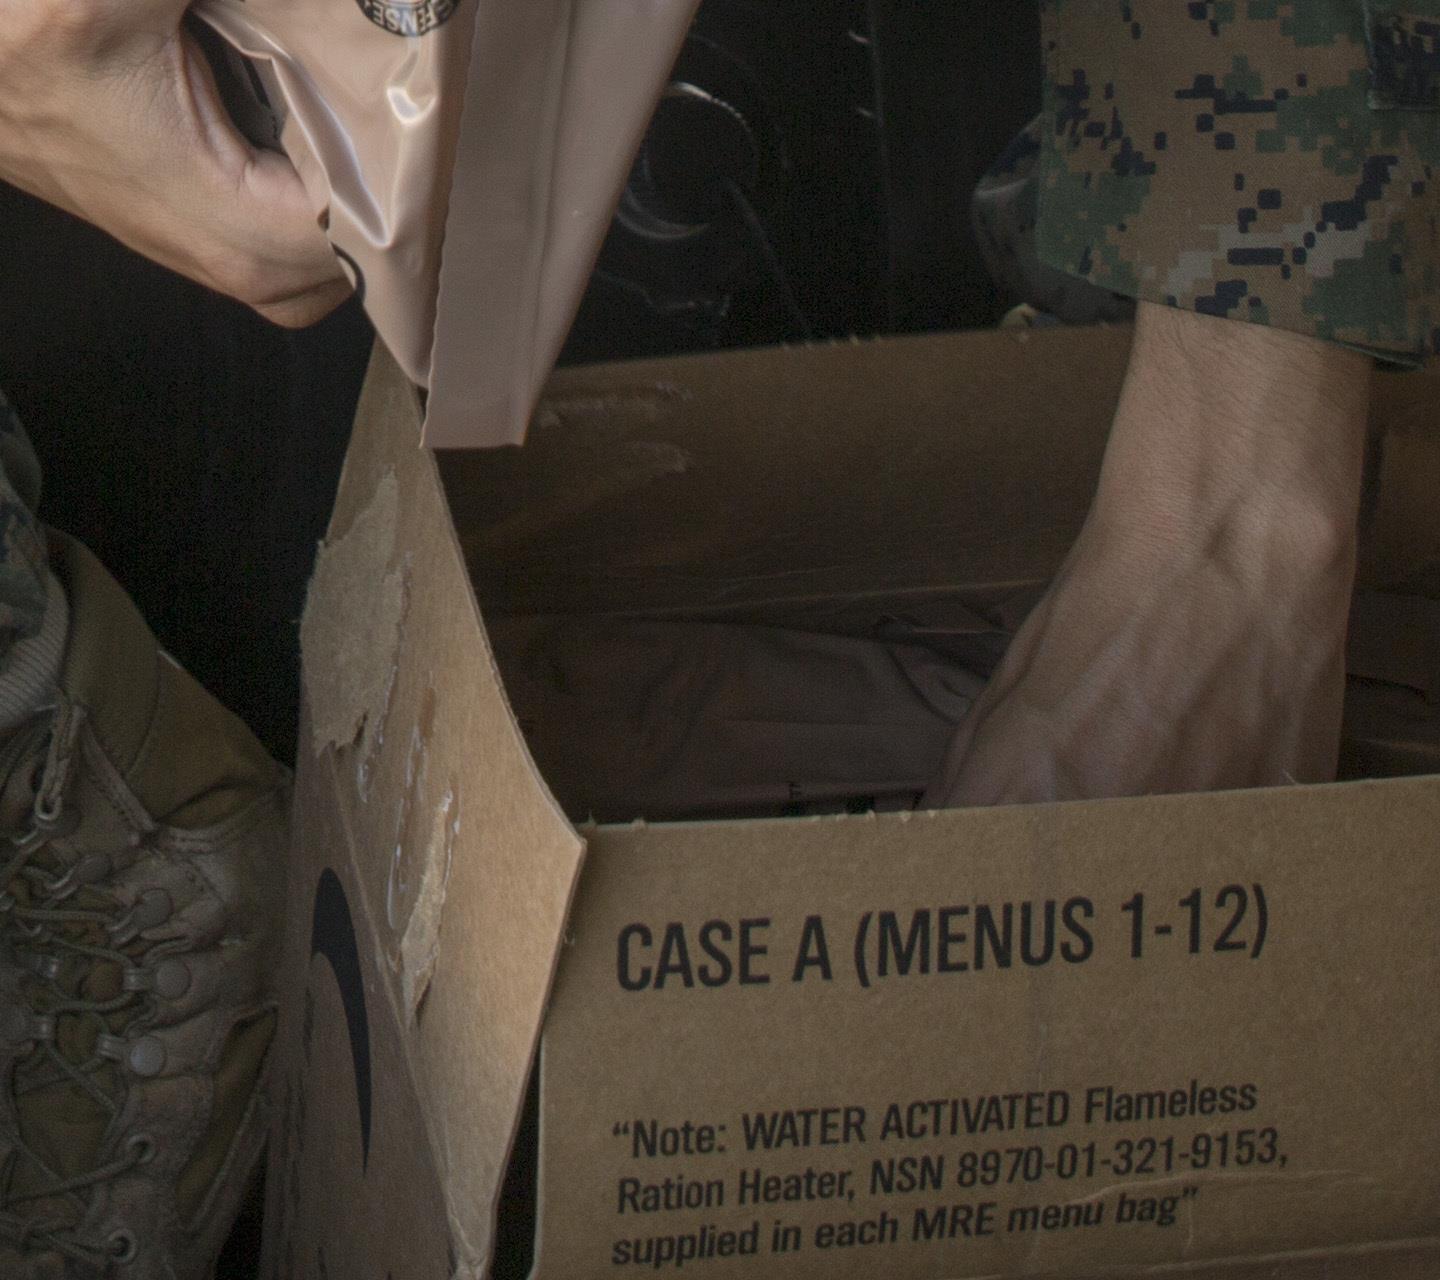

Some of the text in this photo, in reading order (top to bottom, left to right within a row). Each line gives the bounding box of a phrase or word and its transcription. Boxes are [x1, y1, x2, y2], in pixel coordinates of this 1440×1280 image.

[616, 882, 1269, 992] CASE A (MENUS 1-12)
[741, 1105, 867, 1152] WATER
[880, 1089, 1071, 1141] ACTIVATED
[1083, 1079, 1258, 1126] Flameless
[617, 1127, 1290, 1215] Ration Heater, NSN 8970-01-321-9153,
[611, 1223, 760, 1270] supplied
[771, 1220, 802, 1253] in
[814, 1209, 900, 1251] each
[910, 1201, 996, 1242] MRE
[1007, 1200, 1105, 1234] menu
